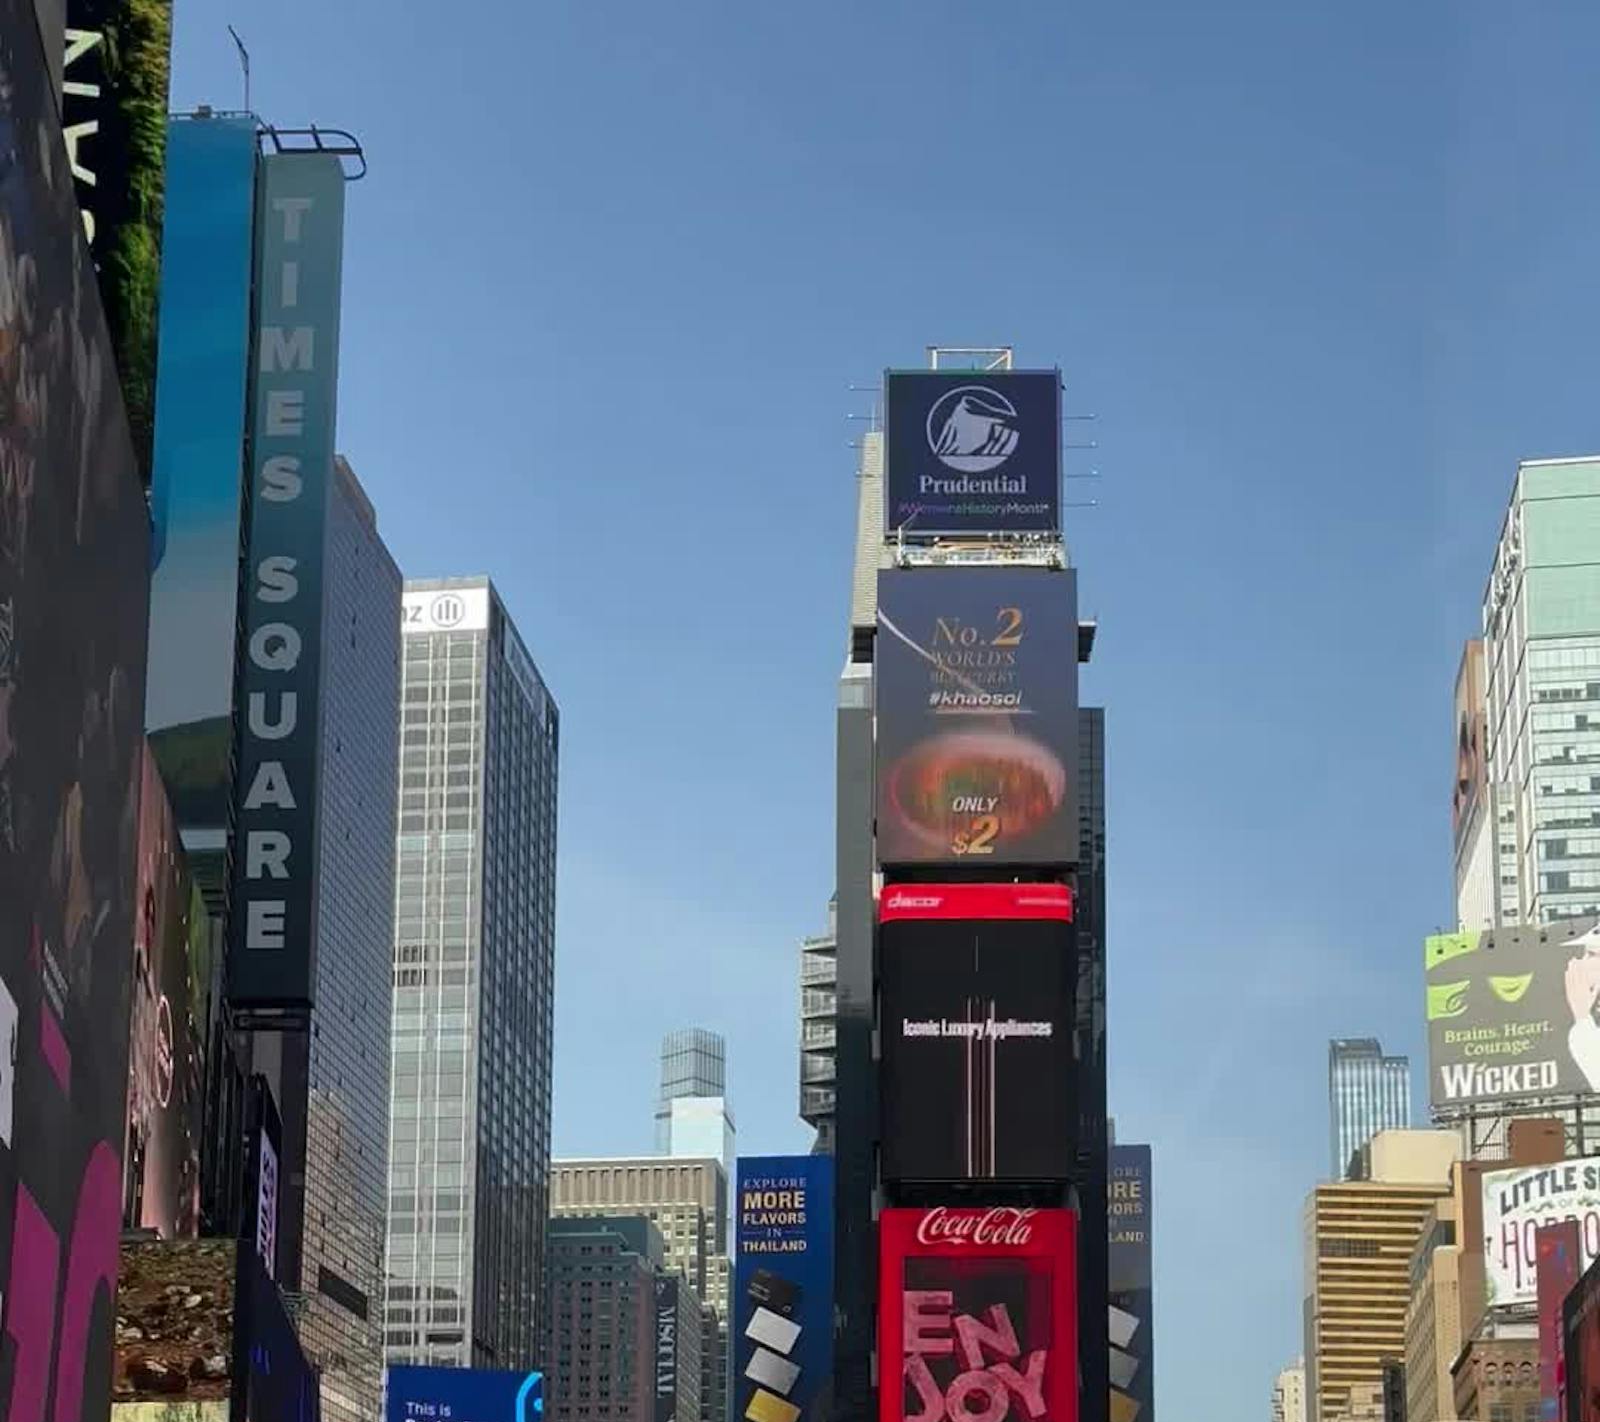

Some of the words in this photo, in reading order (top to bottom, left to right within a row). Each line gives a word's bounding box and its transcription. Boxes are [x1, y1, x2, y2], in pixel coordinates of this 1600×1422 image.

[259, 197, 316, 502] TIMES
[918, 475, 1027, 494] Prudential
[243, 556, 302, 950] SQUARE
[952, 796, 998, 813] ONLY
[951, 814, 1001, 855] $2
[941, 1018, 985, 1041] Luxury
[985, 1018, 1053, 1041] Appliances
[1504, 1020, 1554, 1037] Heart.
[743, 1177, 807, 1190] EXPLORE
[1500, 1166, 1578, 1216] LITTLE
[744, 1191, 806, 1210] MORE
[743, 1212, 807, 1225] FLAVORS
[917, 1206, 1039, 1246] Coca-Cola
[766, 1227, 783, 1238] IN
[743, 1239, 808, 1252] THAILAND
[903, 1290, 1020, 1371] EN
[406, 1402, 436, 1416] This
[440, 1404, 452, 1417] is
